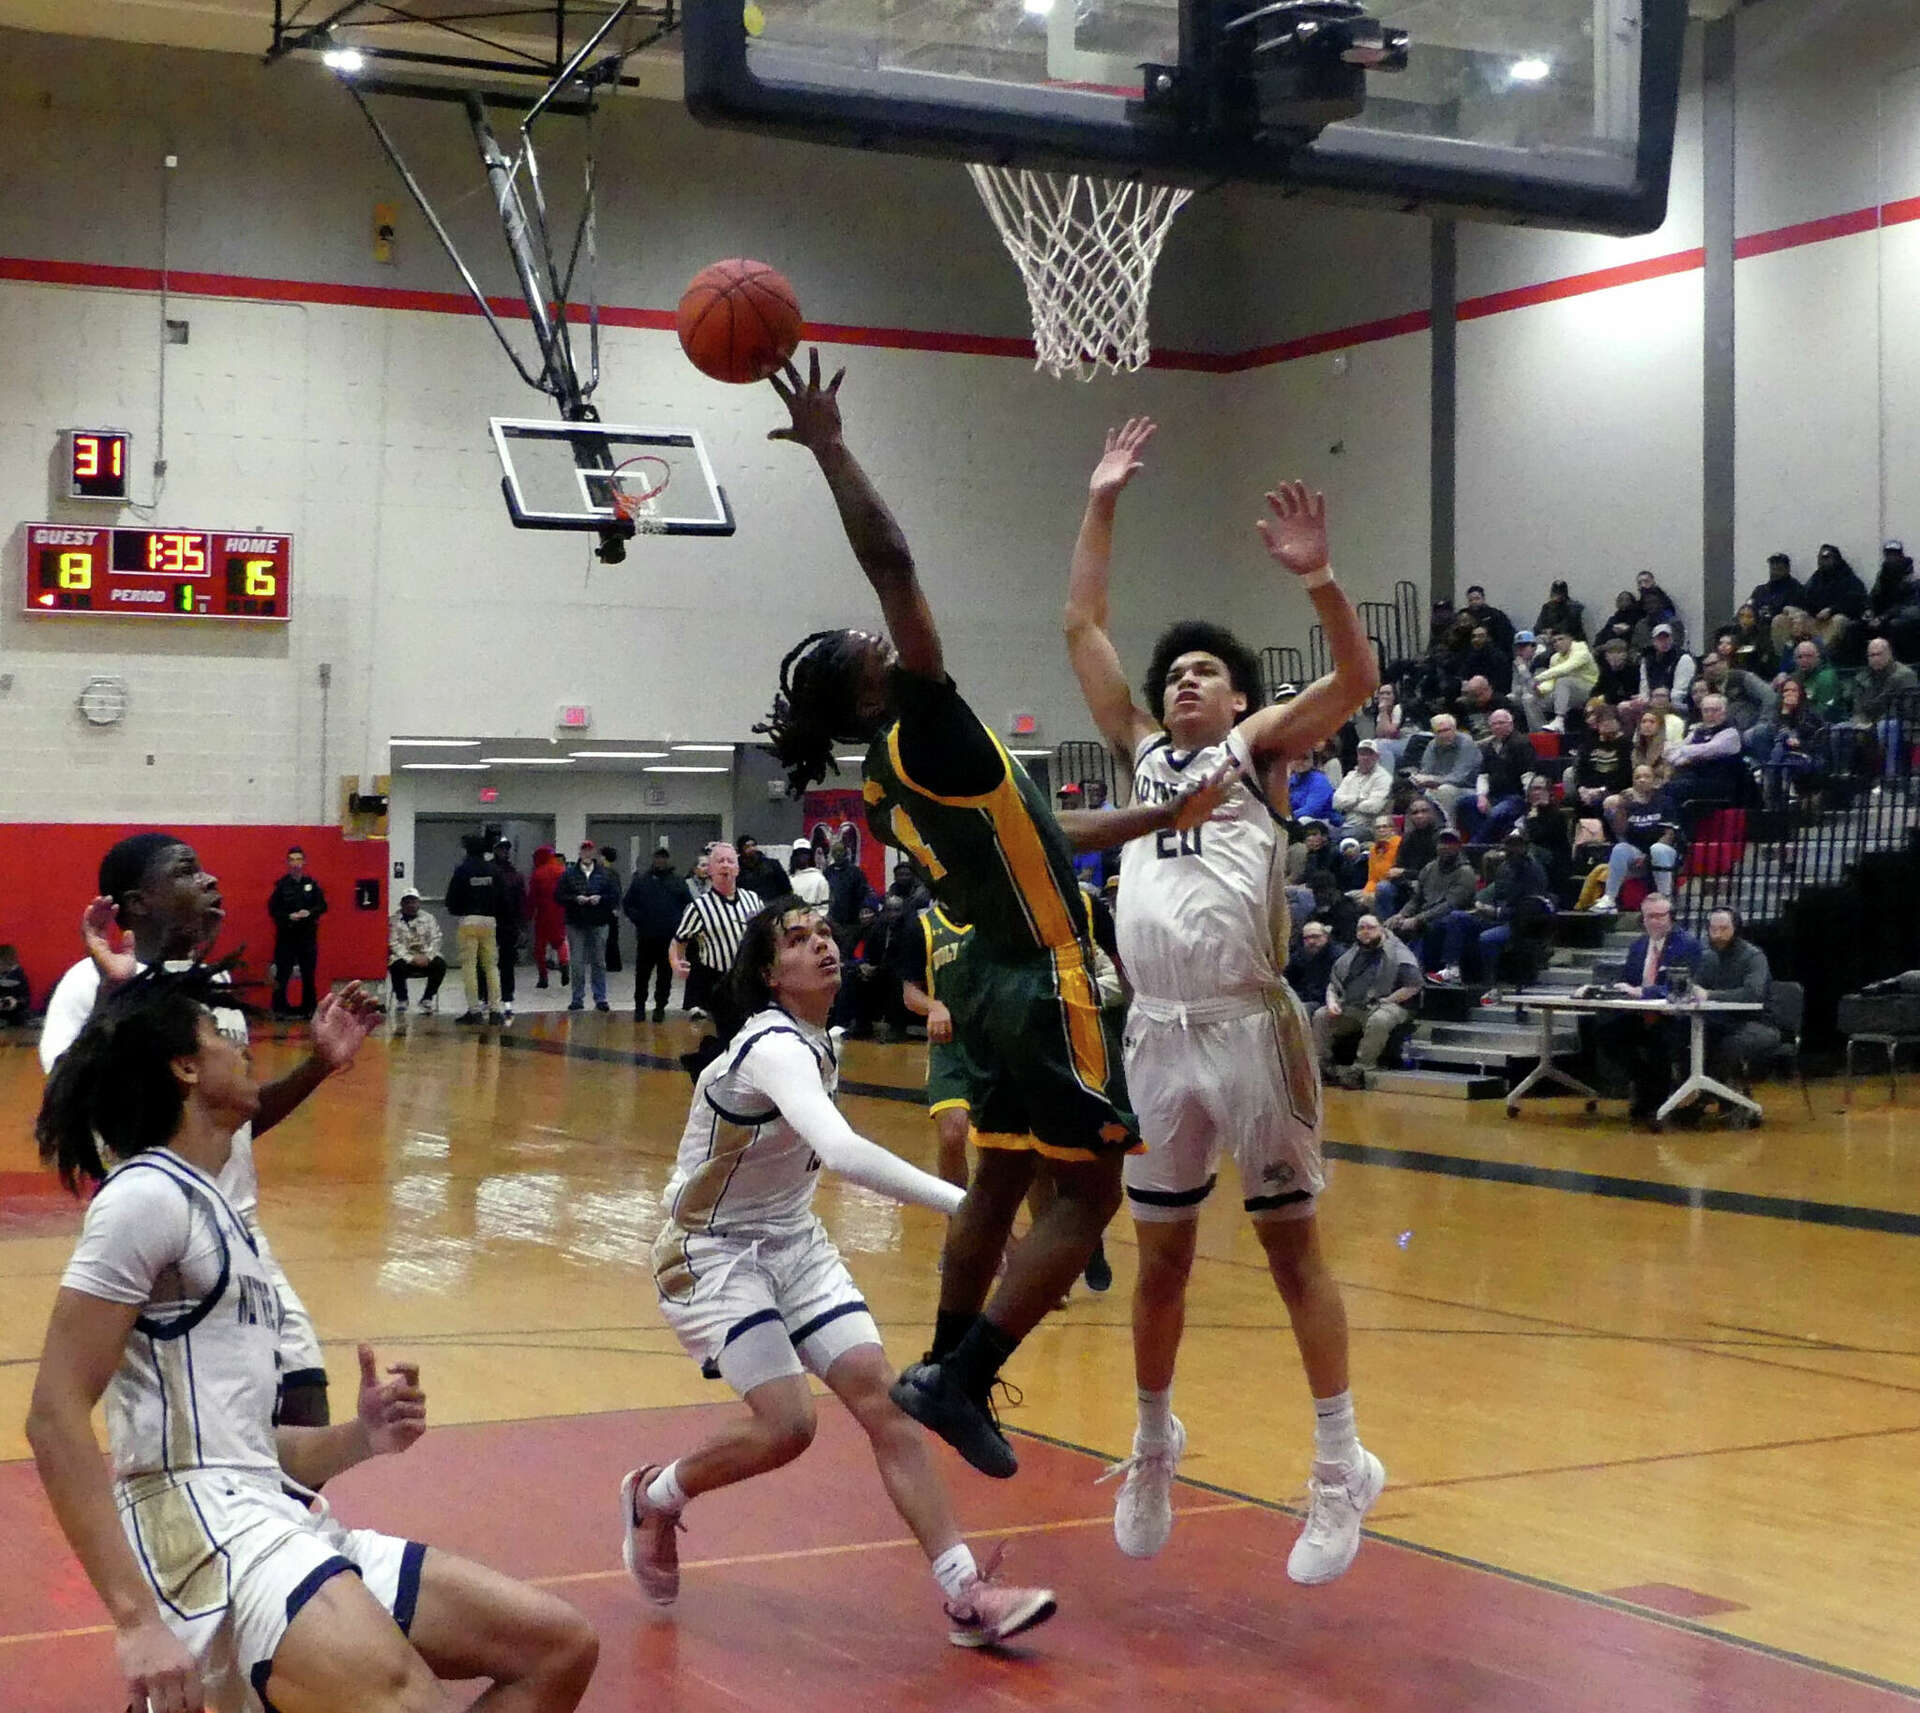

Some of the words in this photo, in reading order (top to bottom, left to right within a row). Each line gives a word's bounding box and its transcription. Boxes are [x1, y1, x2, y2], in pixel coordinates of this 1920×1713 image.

[76, 438, 121, 476] 31
[33, 529, 99, 546] GUEST
[225, 537, 279, 554] HOME
[149, 534, 204, 571] 1:35
[111, 589, 166, 603] PERIOD
[183, 584, 193, 612] 1
